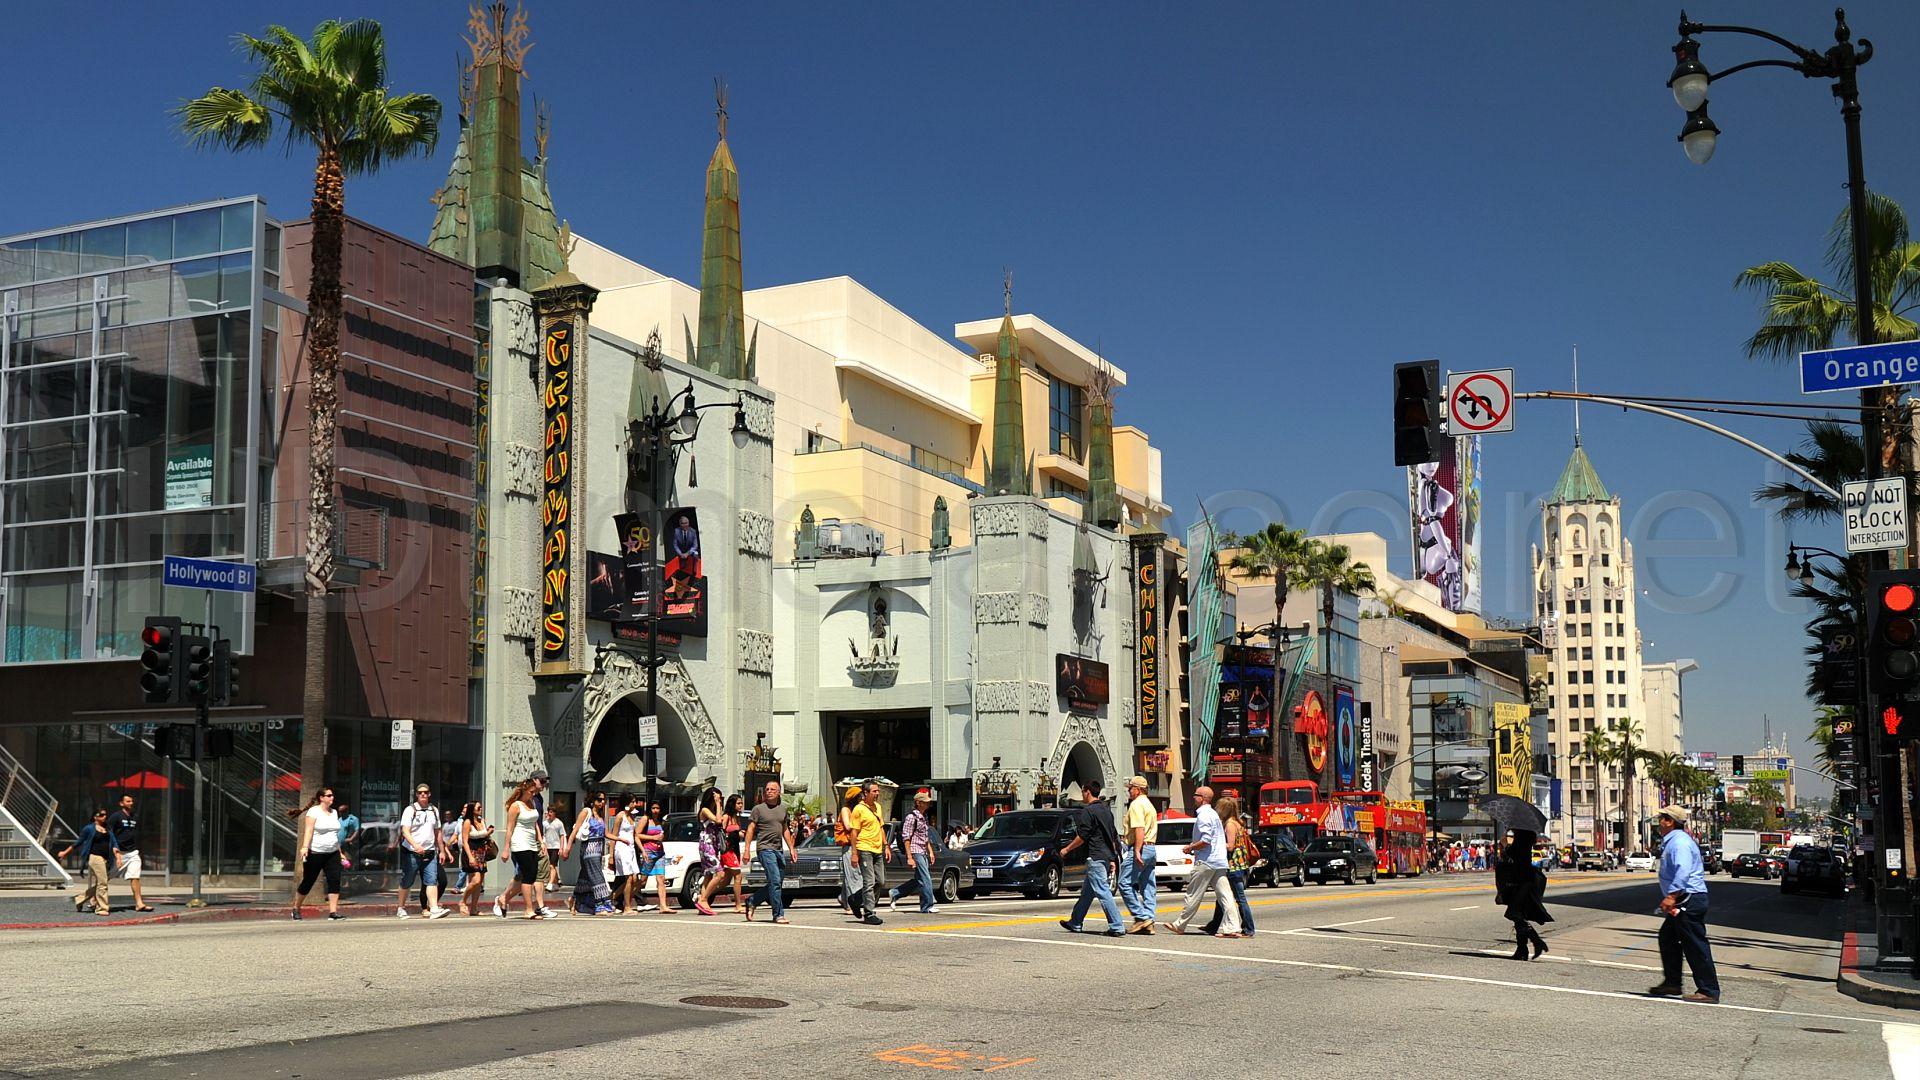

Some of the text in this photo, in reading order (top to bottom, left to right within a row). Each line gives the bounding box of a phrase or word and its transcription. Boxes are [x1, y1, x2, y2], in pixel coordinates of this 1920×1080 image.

[1824, 356, 1918, 381] Orange
[167, 457, 212, 471] Available
[1848, 488, 1901, 508] DO NOT
[1849, 511, 1903, 530] BLOCK
[631, 526, 650, 551] 50
[1850, 530, 1904, 545] INTERSECTION
[169, 563, 250, 585] Hollywood Bl
[1140, 564, 1156, 725] CHINESE
[1361, 717, 1371, 759] Theatre
[361, 780, 400, 791] Available
